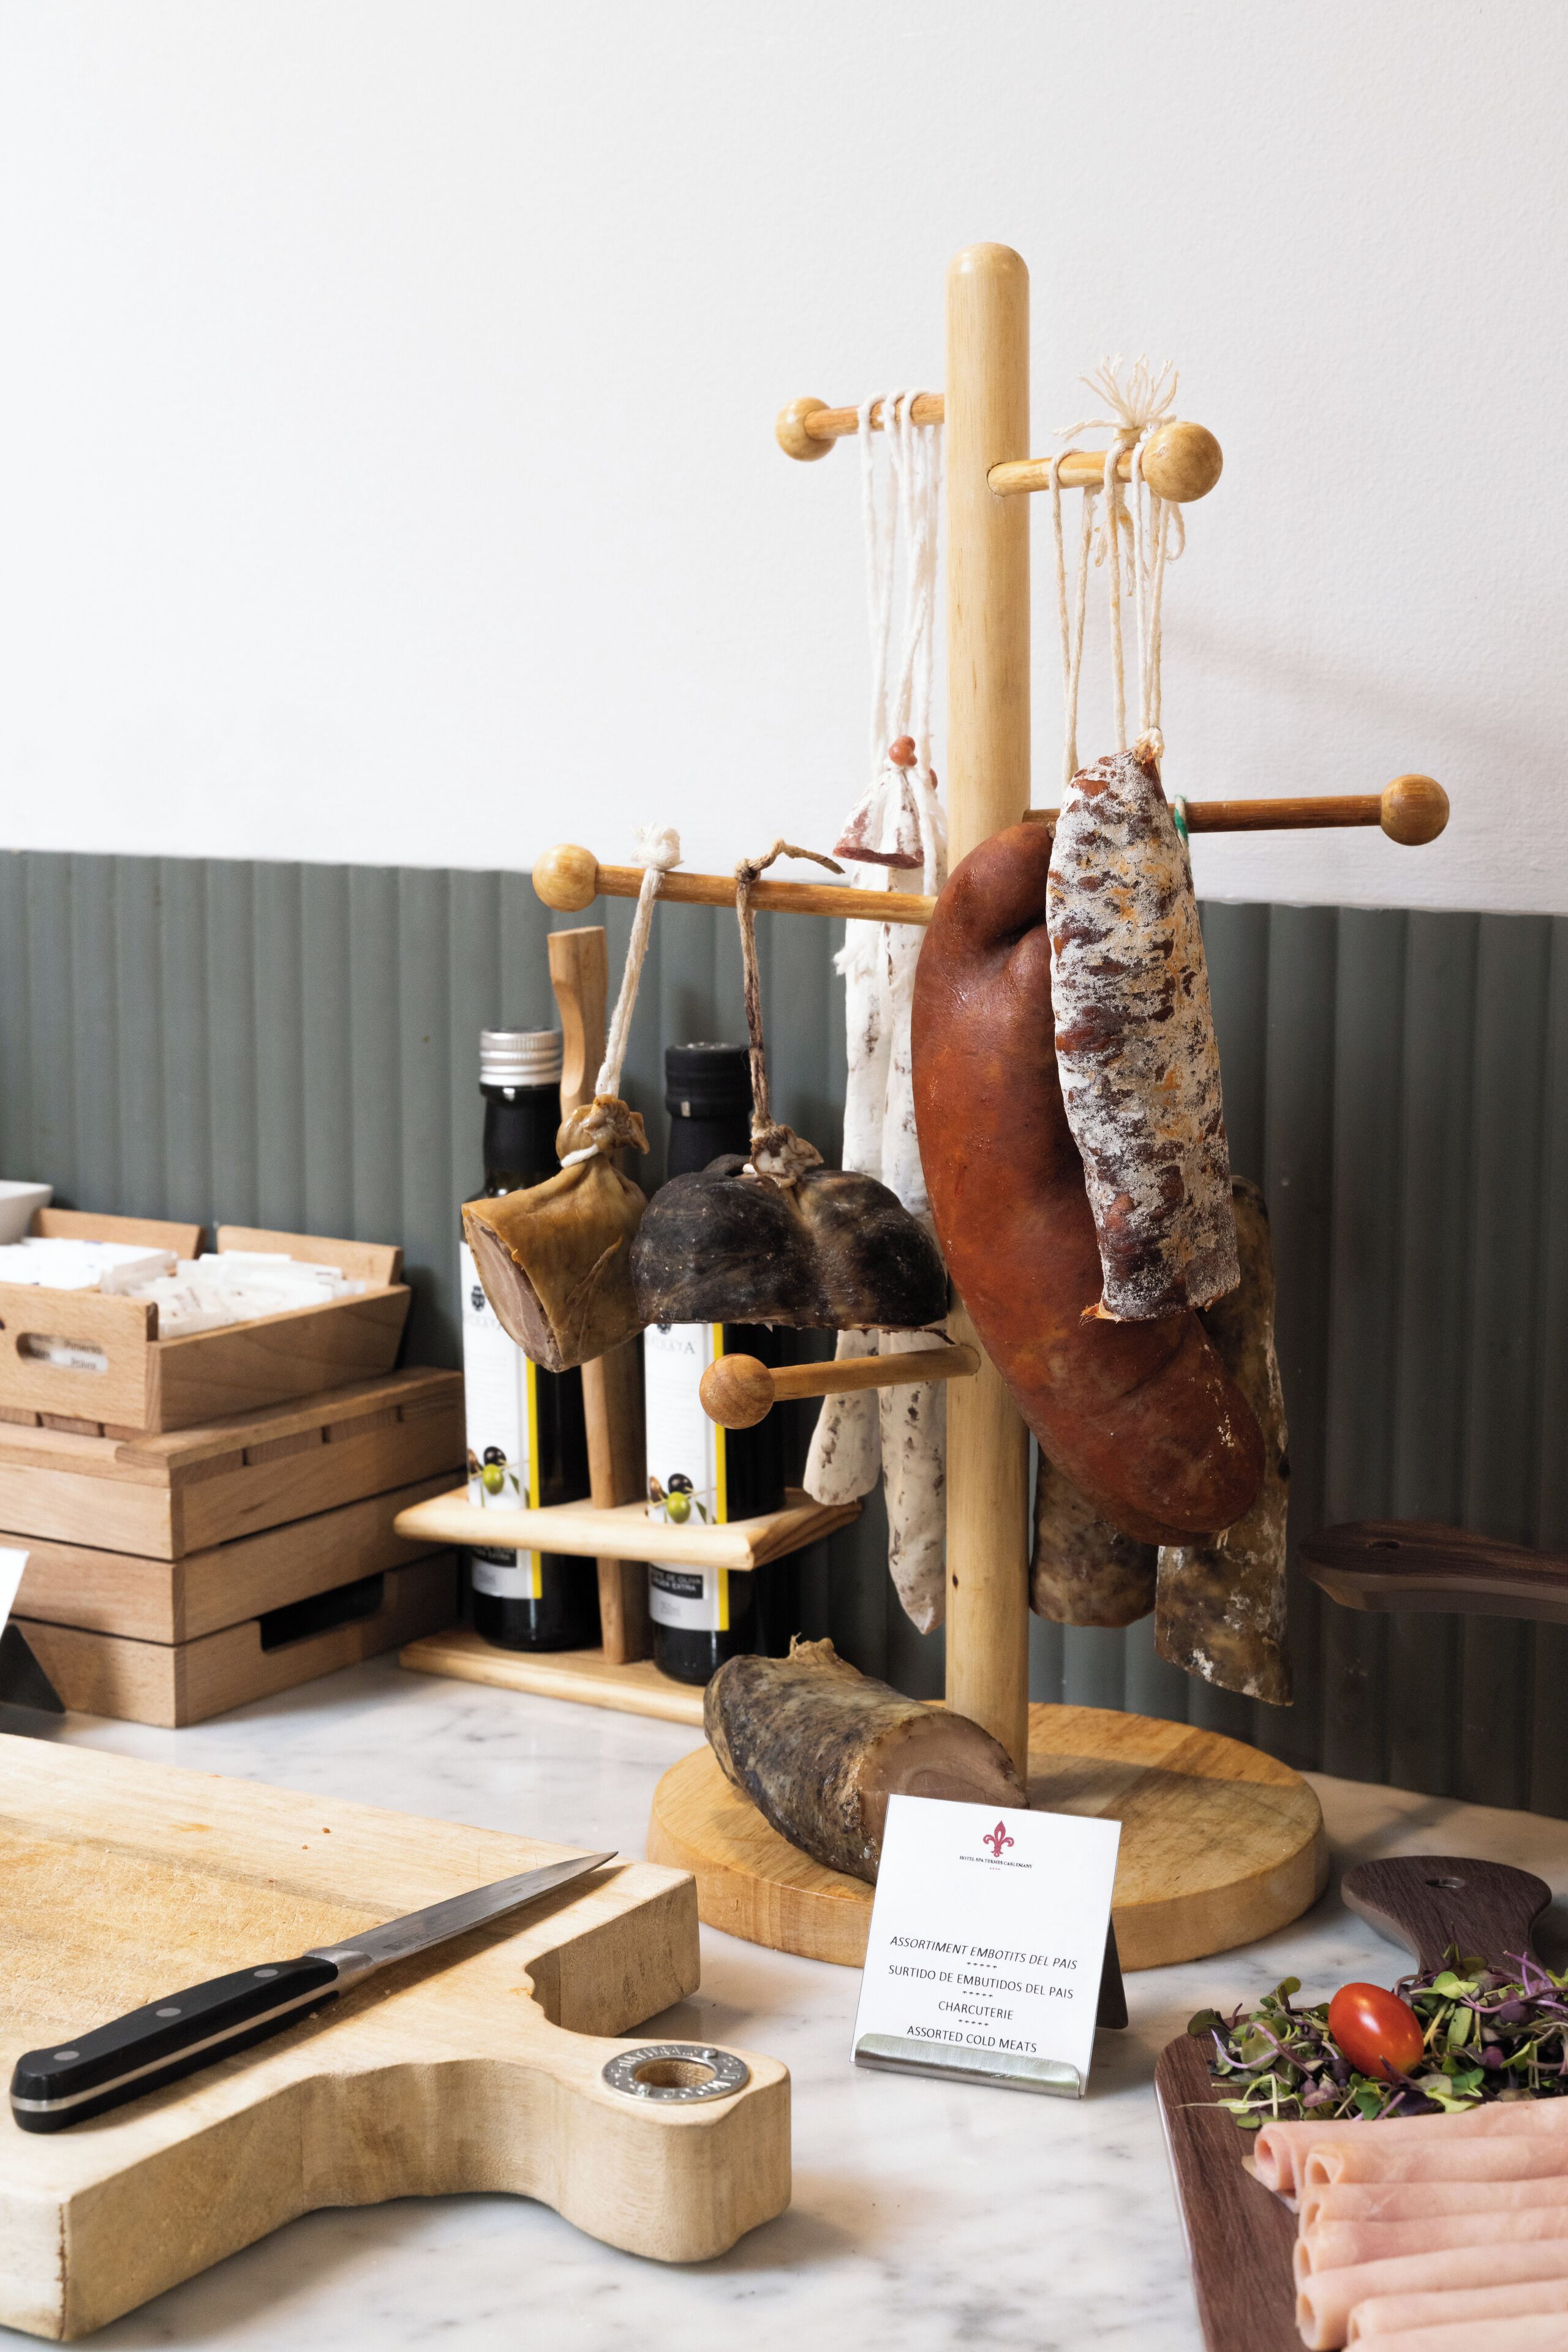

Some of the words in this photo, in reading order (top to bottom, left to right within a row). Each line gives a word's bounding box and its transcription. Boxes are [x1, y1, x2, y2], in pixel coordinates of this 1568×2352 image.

[890, 1936, 968, 1954] ASSORTIMENT
[970, 1947, 1027, 1962] EMBOTITS
[1029, 1954, 1049, 1966] DEL
[1052, 1958, 1077, 1970] PAIS
[889, 1965, 936, 1980] SURTIDO
[939, 1972, 954, 1982] DE
[957, 1974, 1022, 1992] EMBUTIDOS
[1025, 1983, 1046, 1995] DEL
[1049, 1986, 1073, 1999] PAIS
[938, 2000, 1014, 2020] CHARCUTERIE
[907, 2026, 963, 2042] ASSORTED
[966, 2034, 995, 2047] COLD
[999, 2038, 1036, 2052] MEATS
